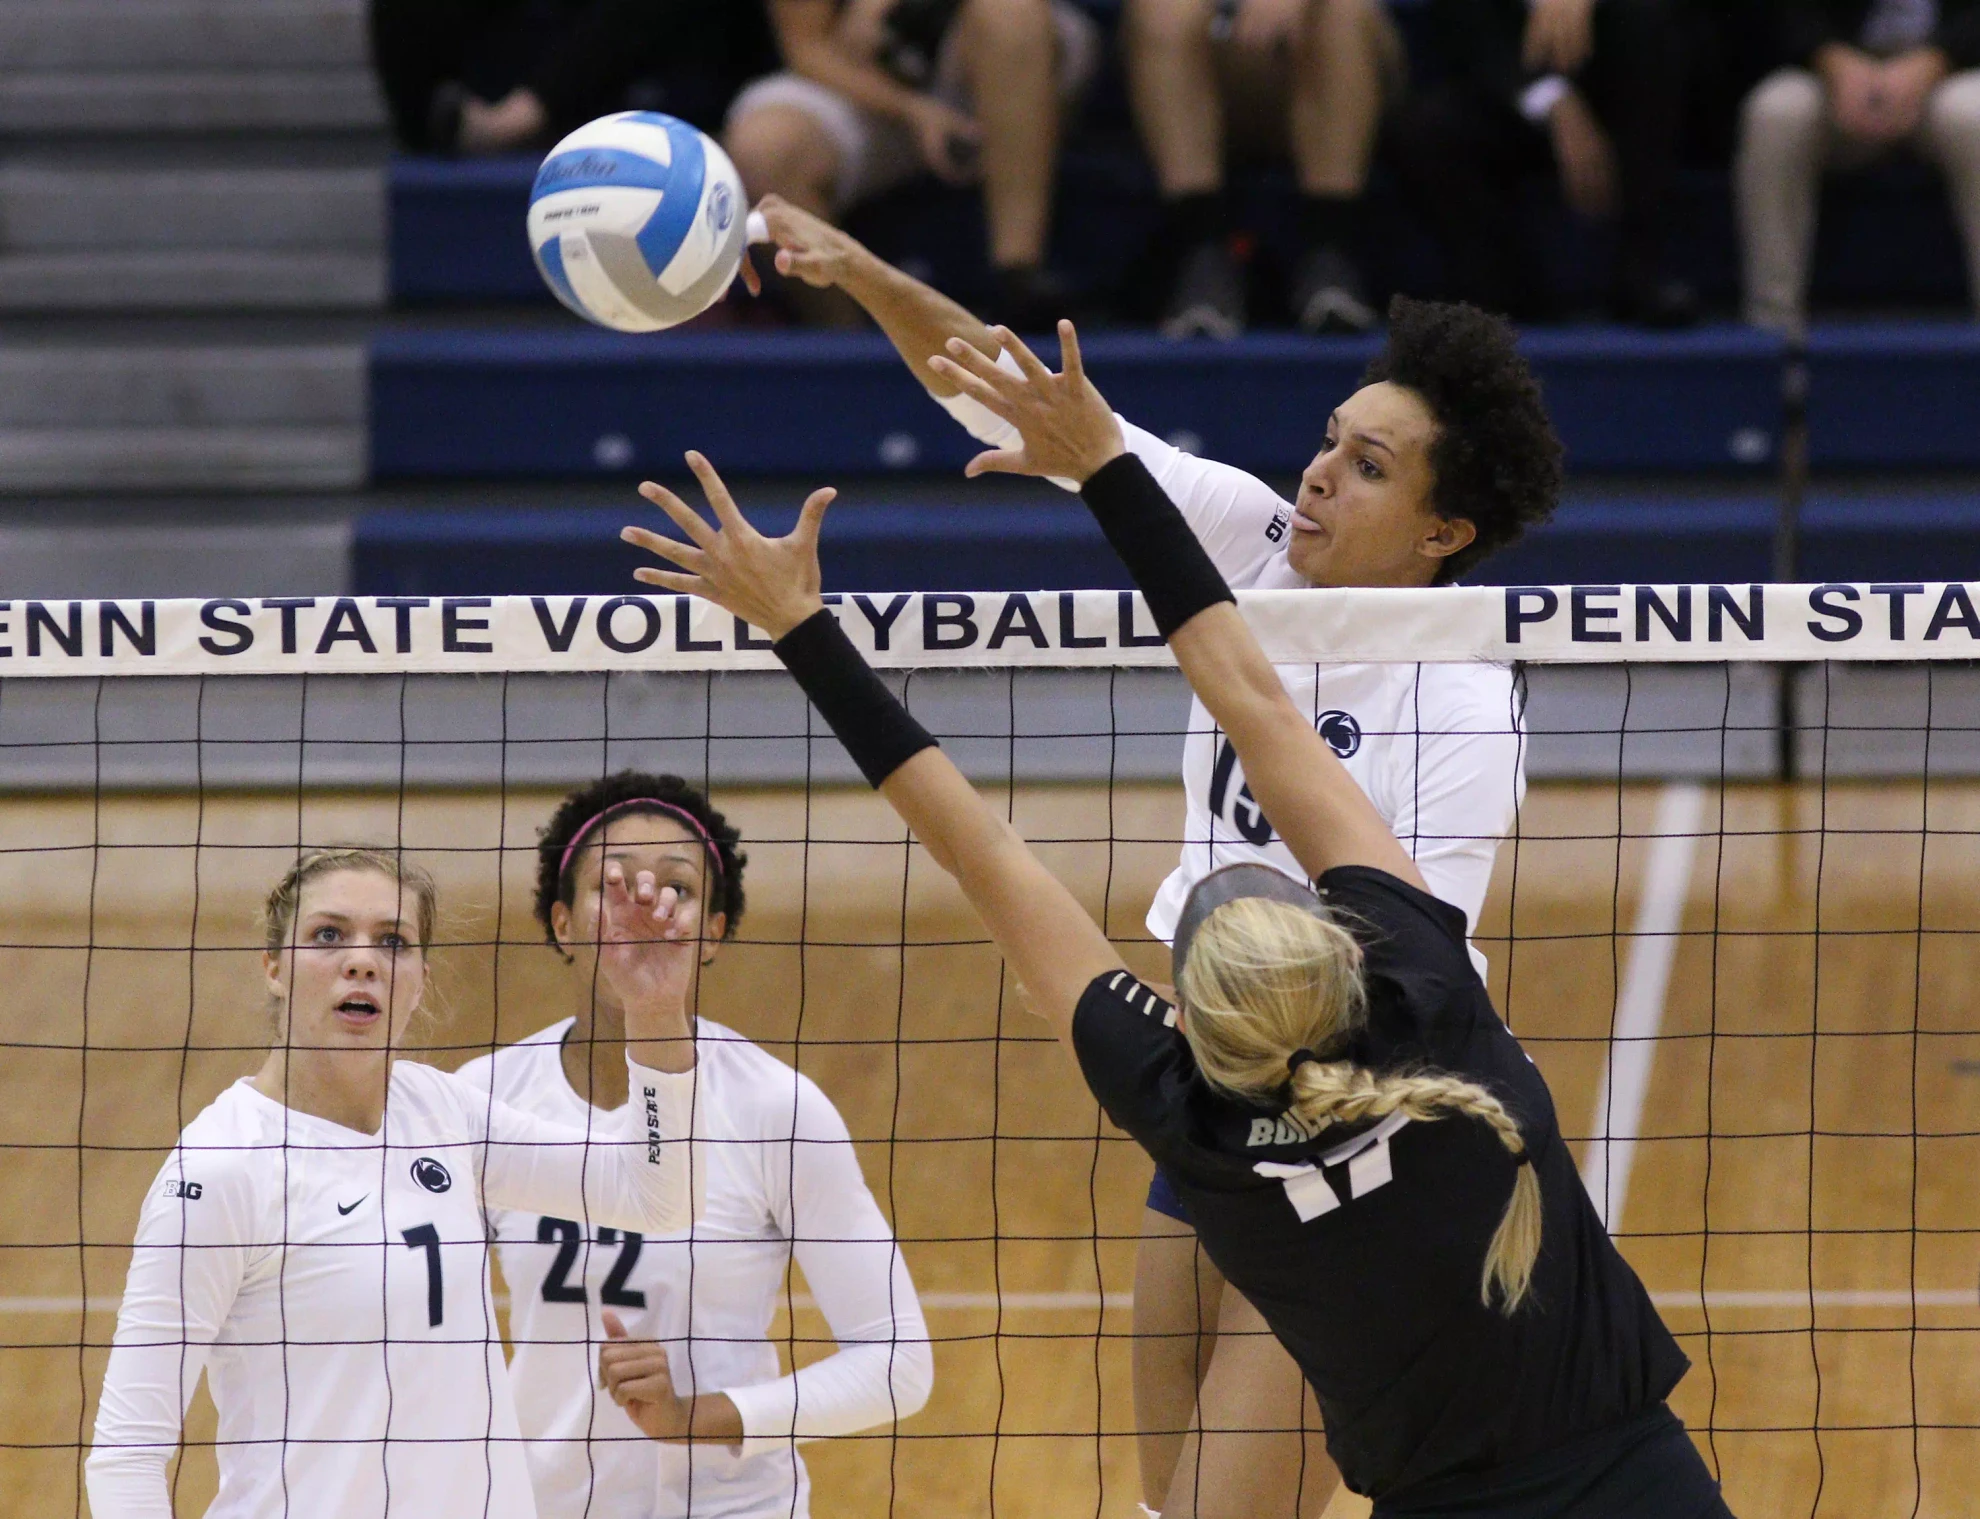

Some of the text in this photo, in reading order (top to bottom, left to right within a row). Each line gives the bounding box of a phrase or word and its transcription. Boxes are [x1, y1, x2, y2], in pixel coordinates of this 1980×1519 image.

[0, 592, 1166, 657] NN STATE VOLLYBALL
[1504, 583, 1980, 644] PENN STA
[538, 1215, 647, 1309] 22
